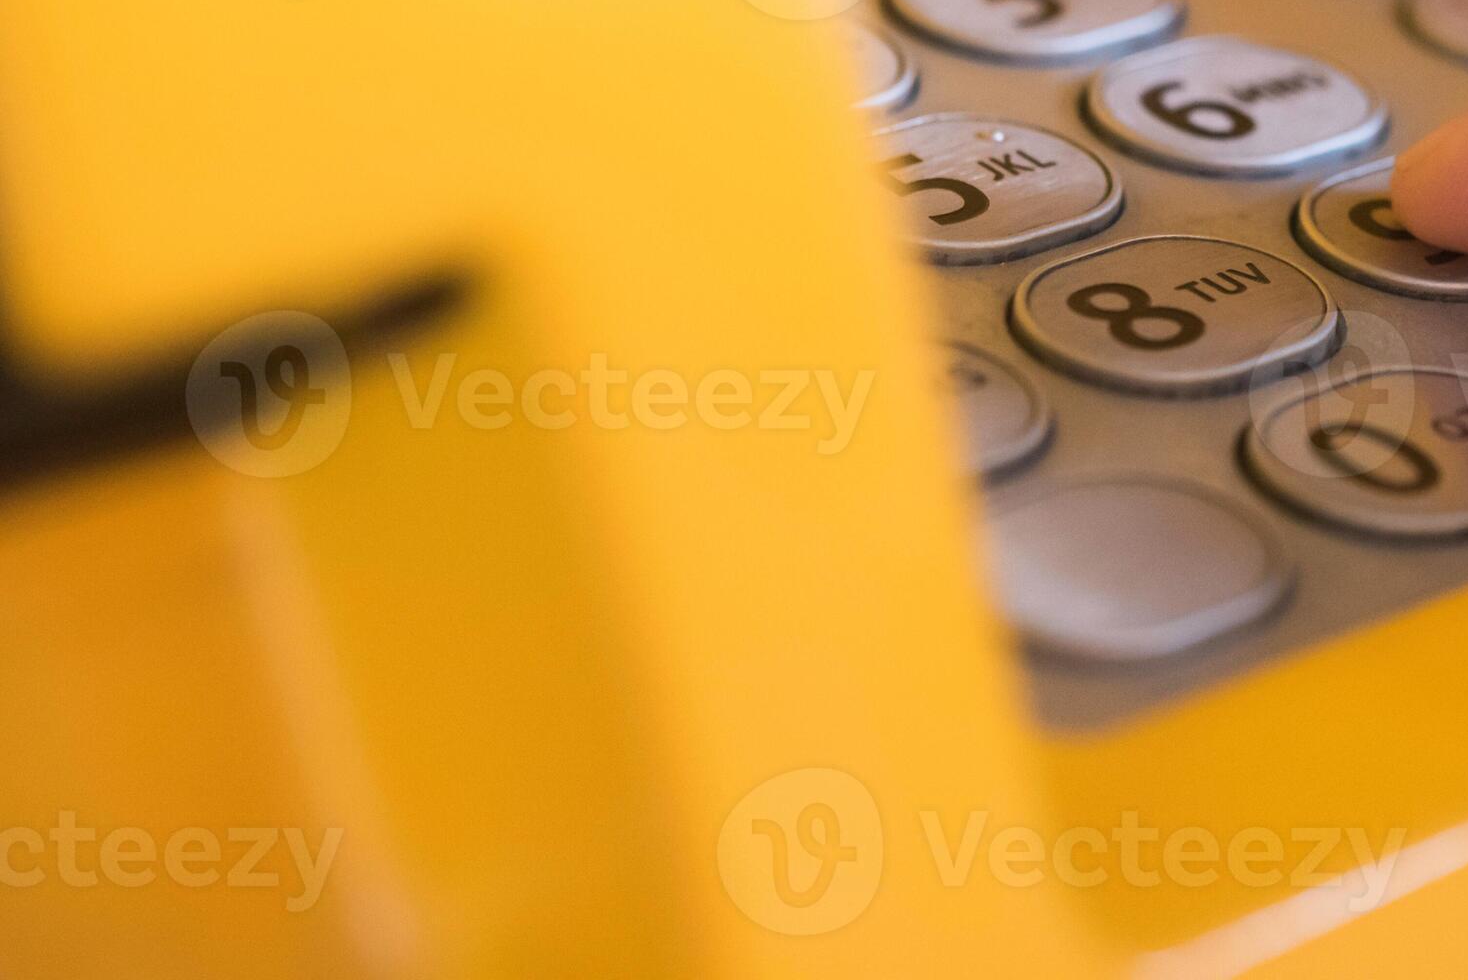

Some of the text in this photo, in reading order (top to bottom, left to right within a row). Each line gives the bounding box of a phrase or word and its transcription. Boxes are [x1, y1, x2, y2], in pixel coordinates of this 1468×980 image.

[1139, 81, 1257, 140] 6
[877, 150, 1057, 226] 5 JKL
[1066, 262, 1272, 352] 8 TUV
[1309, 423, 1441, 495] 0
